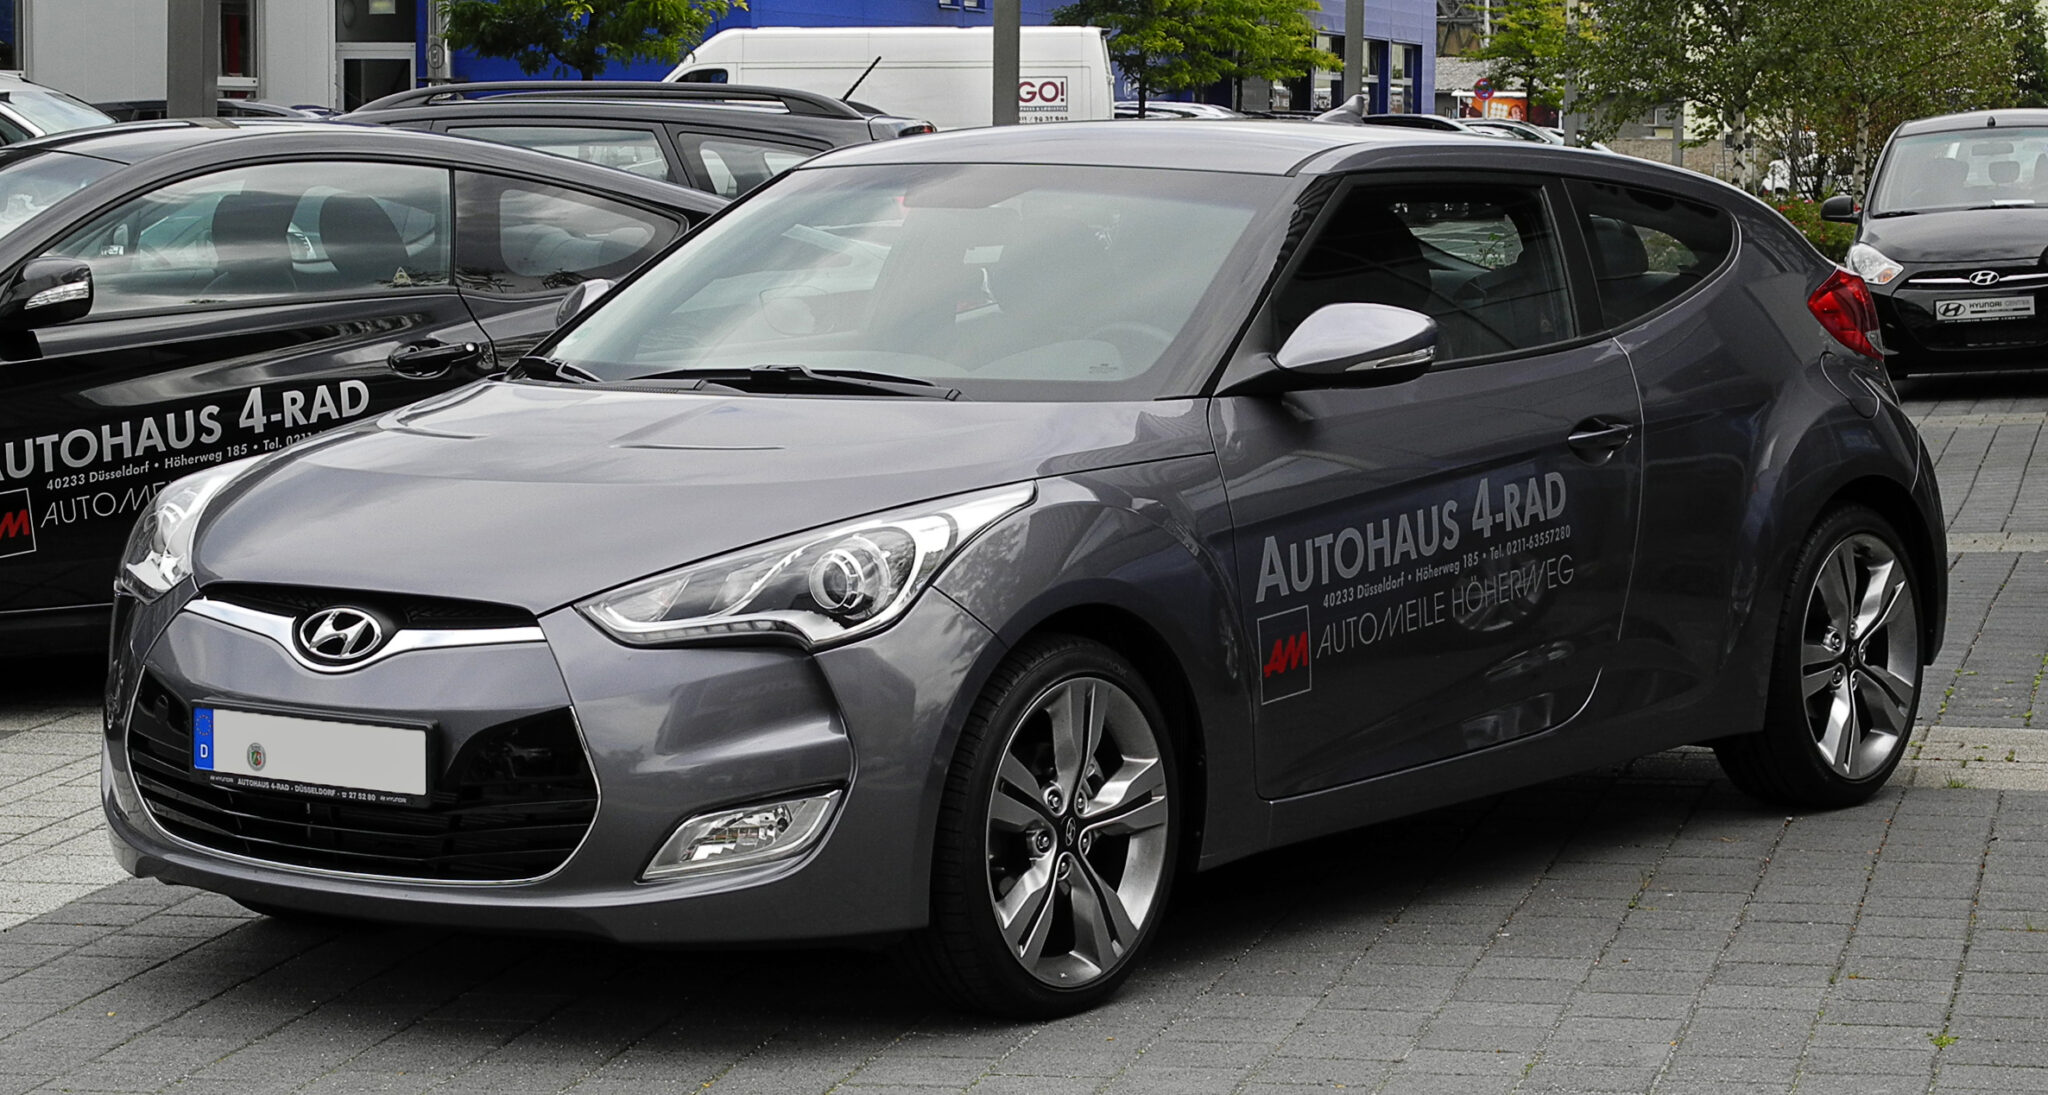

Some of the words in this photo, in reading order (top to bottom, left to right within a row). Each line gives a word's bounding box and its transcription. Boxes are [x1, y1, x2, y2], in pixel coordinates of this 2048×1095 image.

[1018, 81, 1065, 103] GO!
[1969, 301, 2002, 309] HYUNDAI
[0, 404, 223, 481] UTOHAUS
[239, 379, 370, 434] 4-RAD
[47, 474, 86, 491] 40233
[89, 461, 149, 483] Düsseldorf
[164, 450, 223, 469] Höherweg
[227, 443, 248, 458] 185
[263, 436, 283, 451] Tel.
[0, 509, 30, 540] M
[1255, 500, 1460, 603] AUTOHAUS
[1472, 472, 1566, 538] 4-RAD
[1323, 588, 1354, 608] 40233
[1357, 571, 1405, 598] Düsseldorf
[1416, 561, 1460, 582] Höherweg
[1463, 551, 1479, 569] 185
[1490, 543, 1504, 561] Tel.
[1506, 524, 1571, 556] 0211-63557280
[1316, 591, 1445, 659] AUTOMEILE
[1451, 554, 1574, 618] HÖHERWEG
[1263, 631, 1309, 679] AM
[200, 744, 208, 758] D
[237, 778, 270, 789] AUTOHAUS
[270, 781, 290, 791] 4-RAD
[294, 784, 336, 796] DÜSSELDORF
